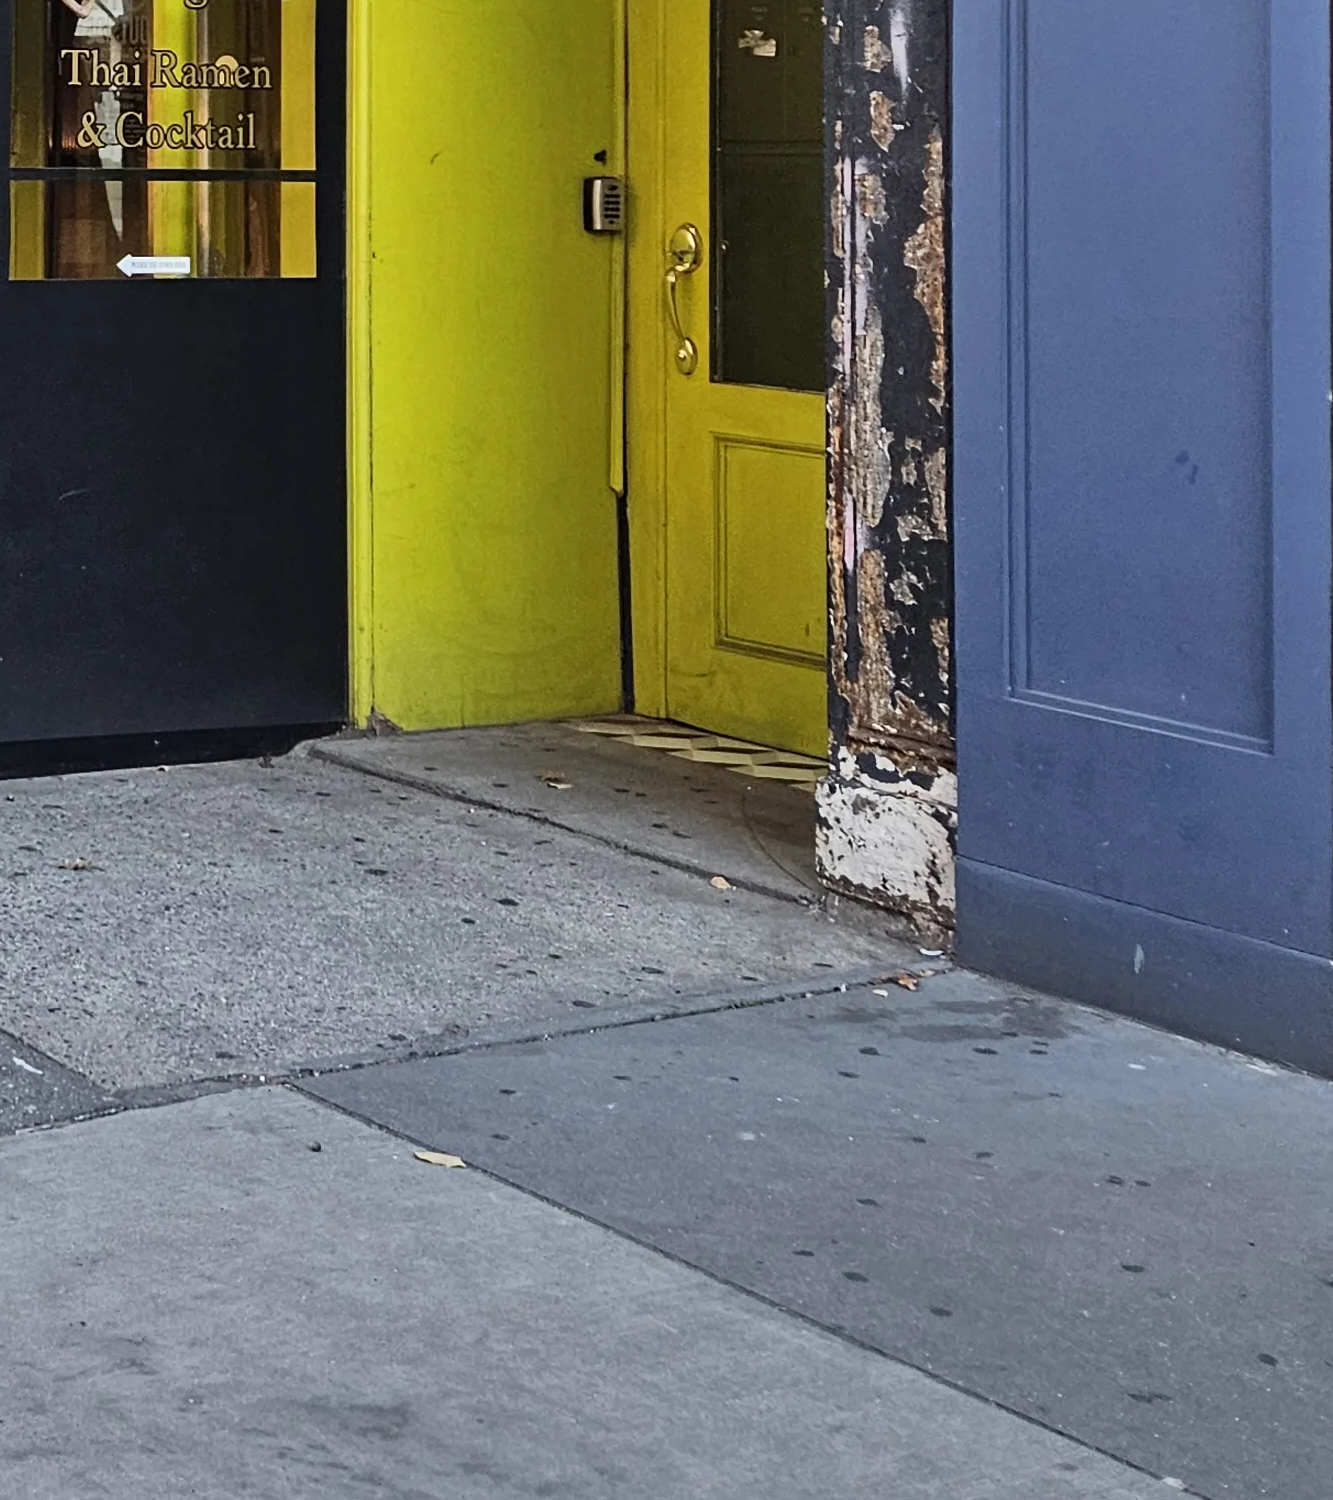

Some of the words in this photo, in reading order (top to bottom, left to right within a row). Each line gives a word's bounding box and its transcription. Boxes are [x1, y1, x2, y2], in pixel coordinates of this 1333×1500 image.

[61, 49, 143, 87] Thai
[150, 50, 273, 89] Ramen
[76, 110, 107, 149] &
[115, 111, 257, 149] Cocktail
